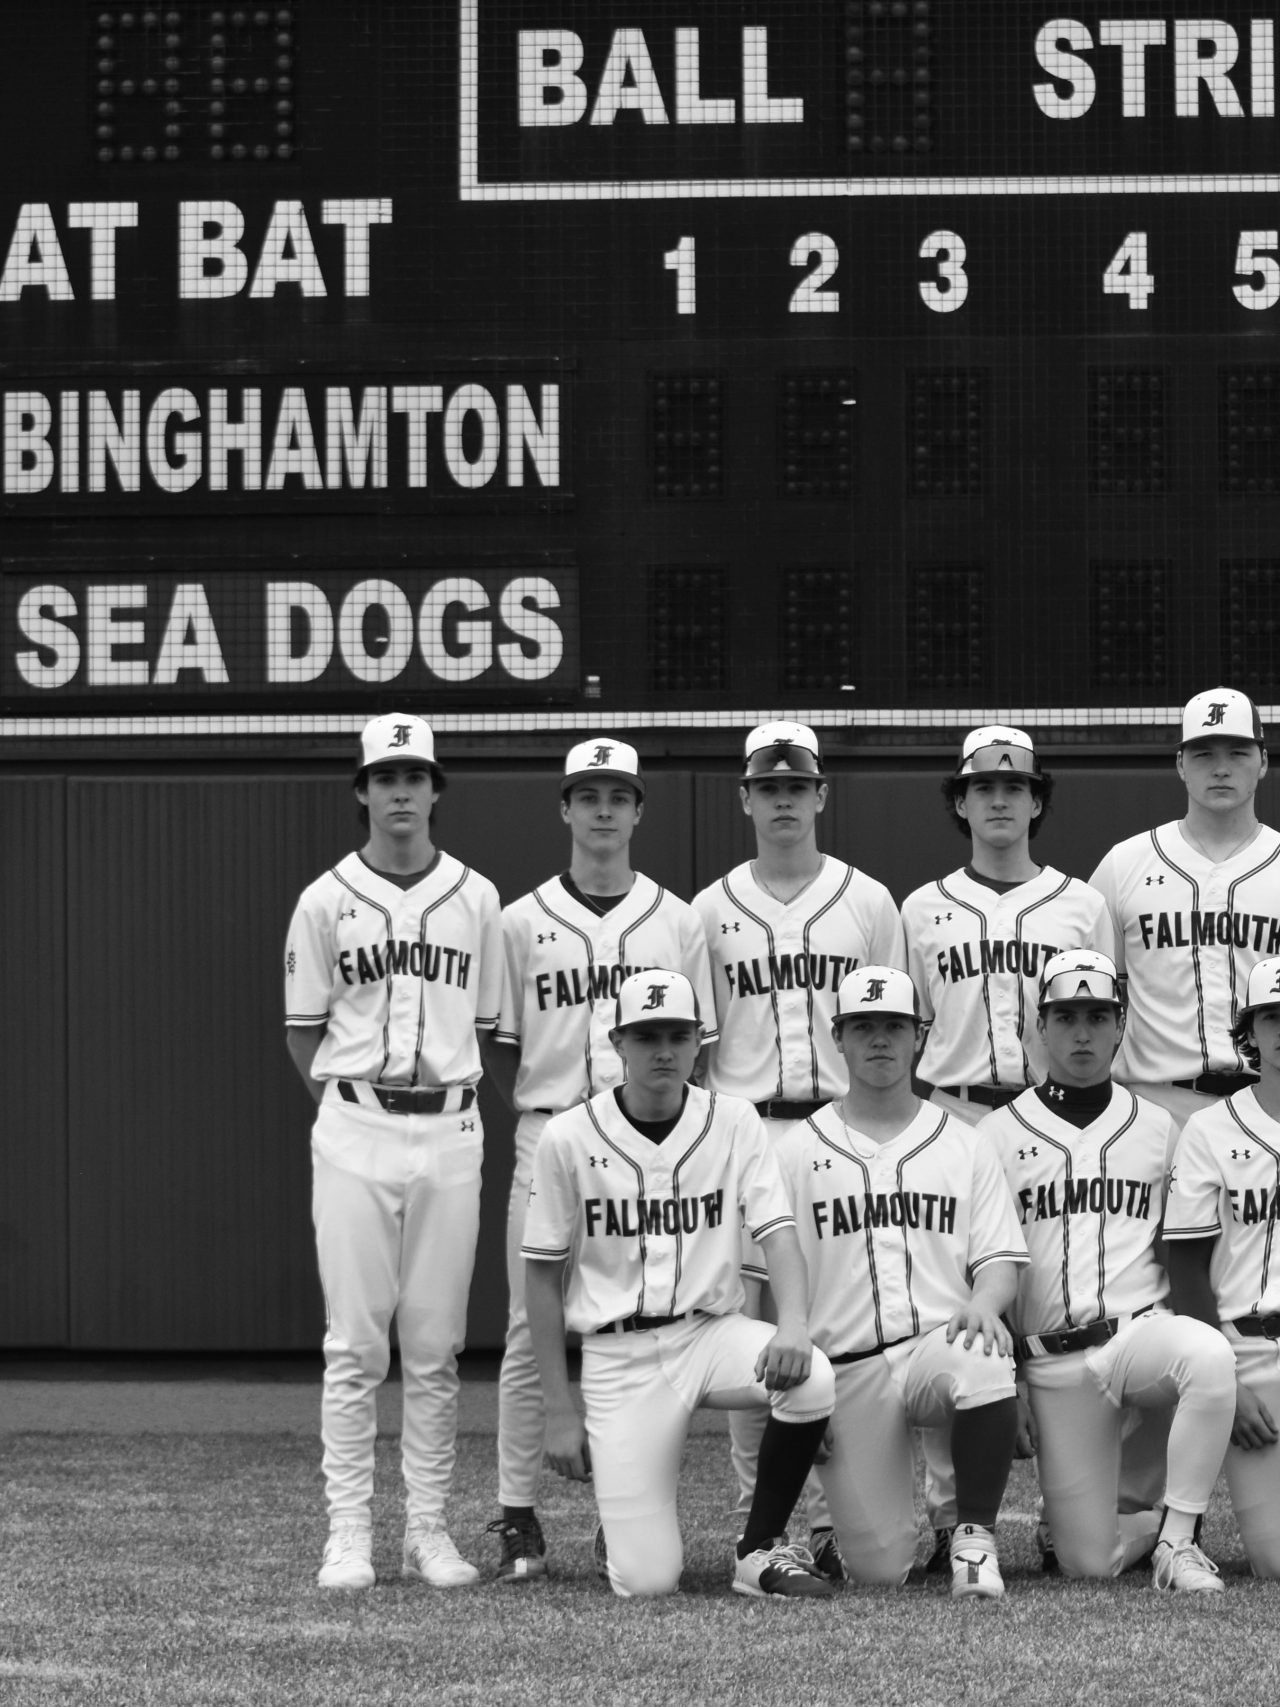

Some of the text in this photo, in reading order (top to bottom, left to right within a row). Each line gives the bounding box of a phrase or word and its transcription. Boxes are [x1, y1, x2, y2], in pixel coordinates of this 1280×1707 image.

[520, 28, 804, 127] BALL
[0, 200, 393, 302] AT BAT
[665, 238, 696, 315] 1
[790, 234, 840, 313] 2
[921, 232, 969, 313] 3
[1105, 233, 1155, 310] 4
[4, 385, 560, 494] BINGHAMTON
[17, 578, 563, 689] SEA DOGS
[339, 940, 471, 989] FALMOUTH
[937, 939, 1065, 985] FALMOUT
[536, 964, 661, 1011] FALMO
[585, 1189, 723, 1237] FALMOUTH
[812, 1192, 957, 1239] FALMOUTH
[1018, 1177, 1152, 1225] FALMOUTH
